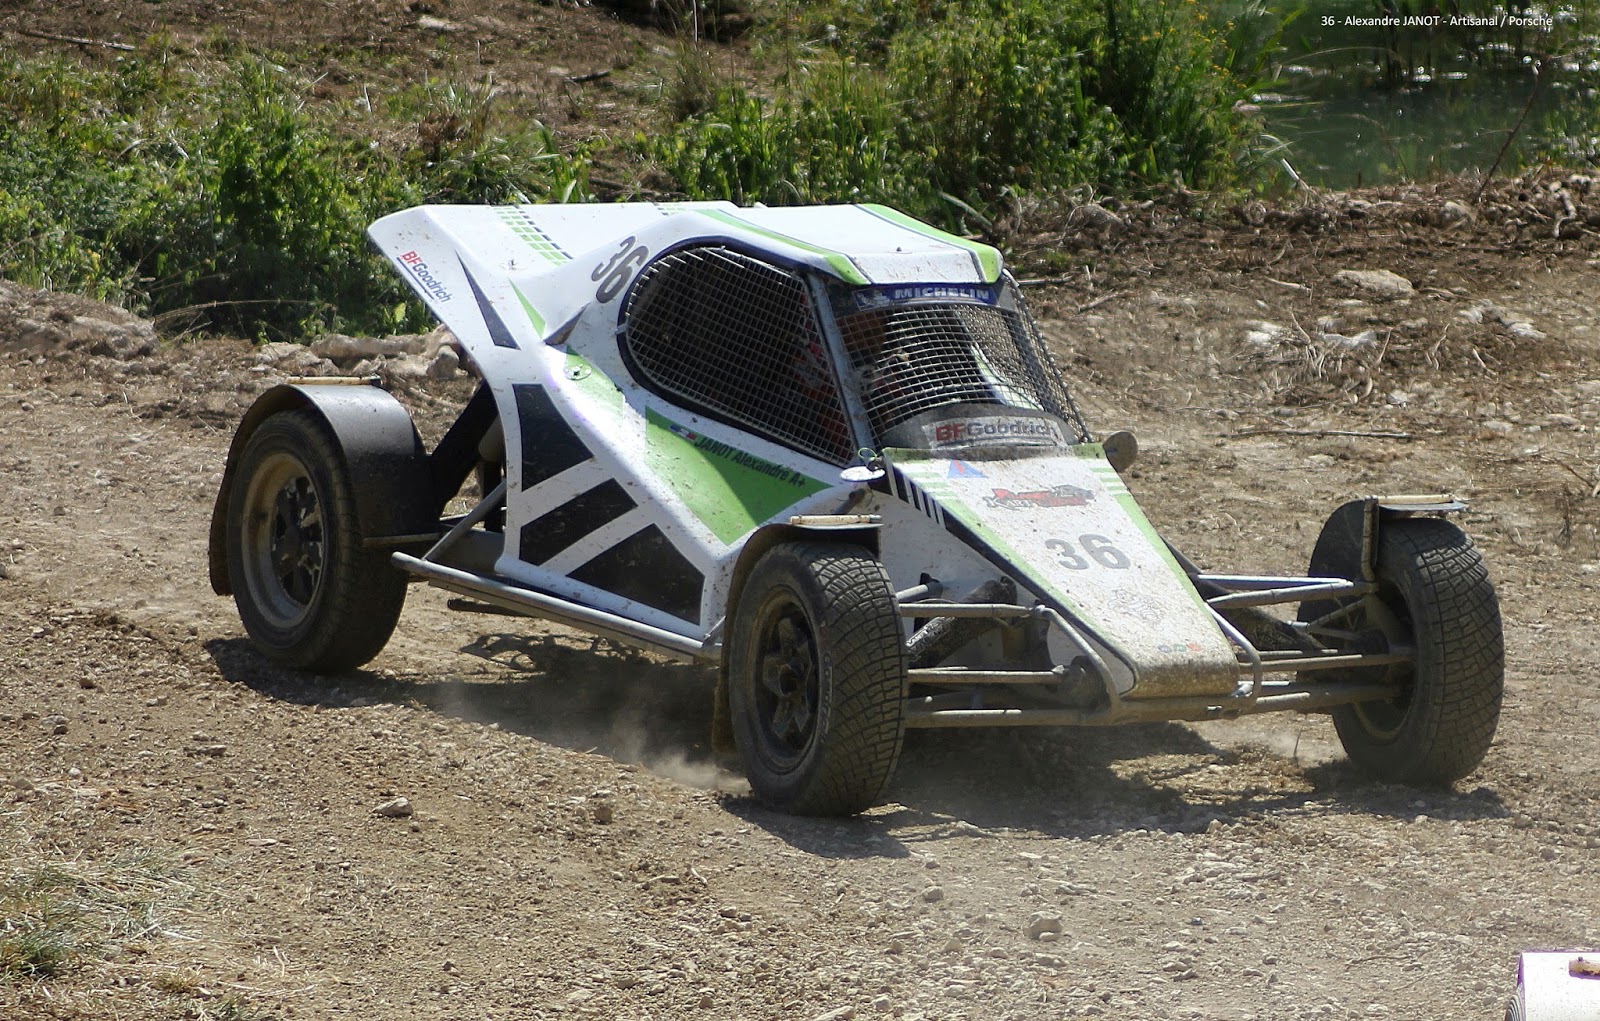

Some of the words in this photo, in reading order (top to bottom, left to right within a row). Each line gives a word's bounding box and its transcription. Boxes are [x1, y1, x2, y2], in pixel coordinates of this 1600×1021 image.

[399, 250, 453, 303] BFGoodrich
[591, 235, 649, 304] 36
[894, 286, 990, 300] MICHELIN
[694, 435, 737, 459] JANOT
[730, 450, 794, 481] Alexandre
[1045, 533, 1131, 571] 36
